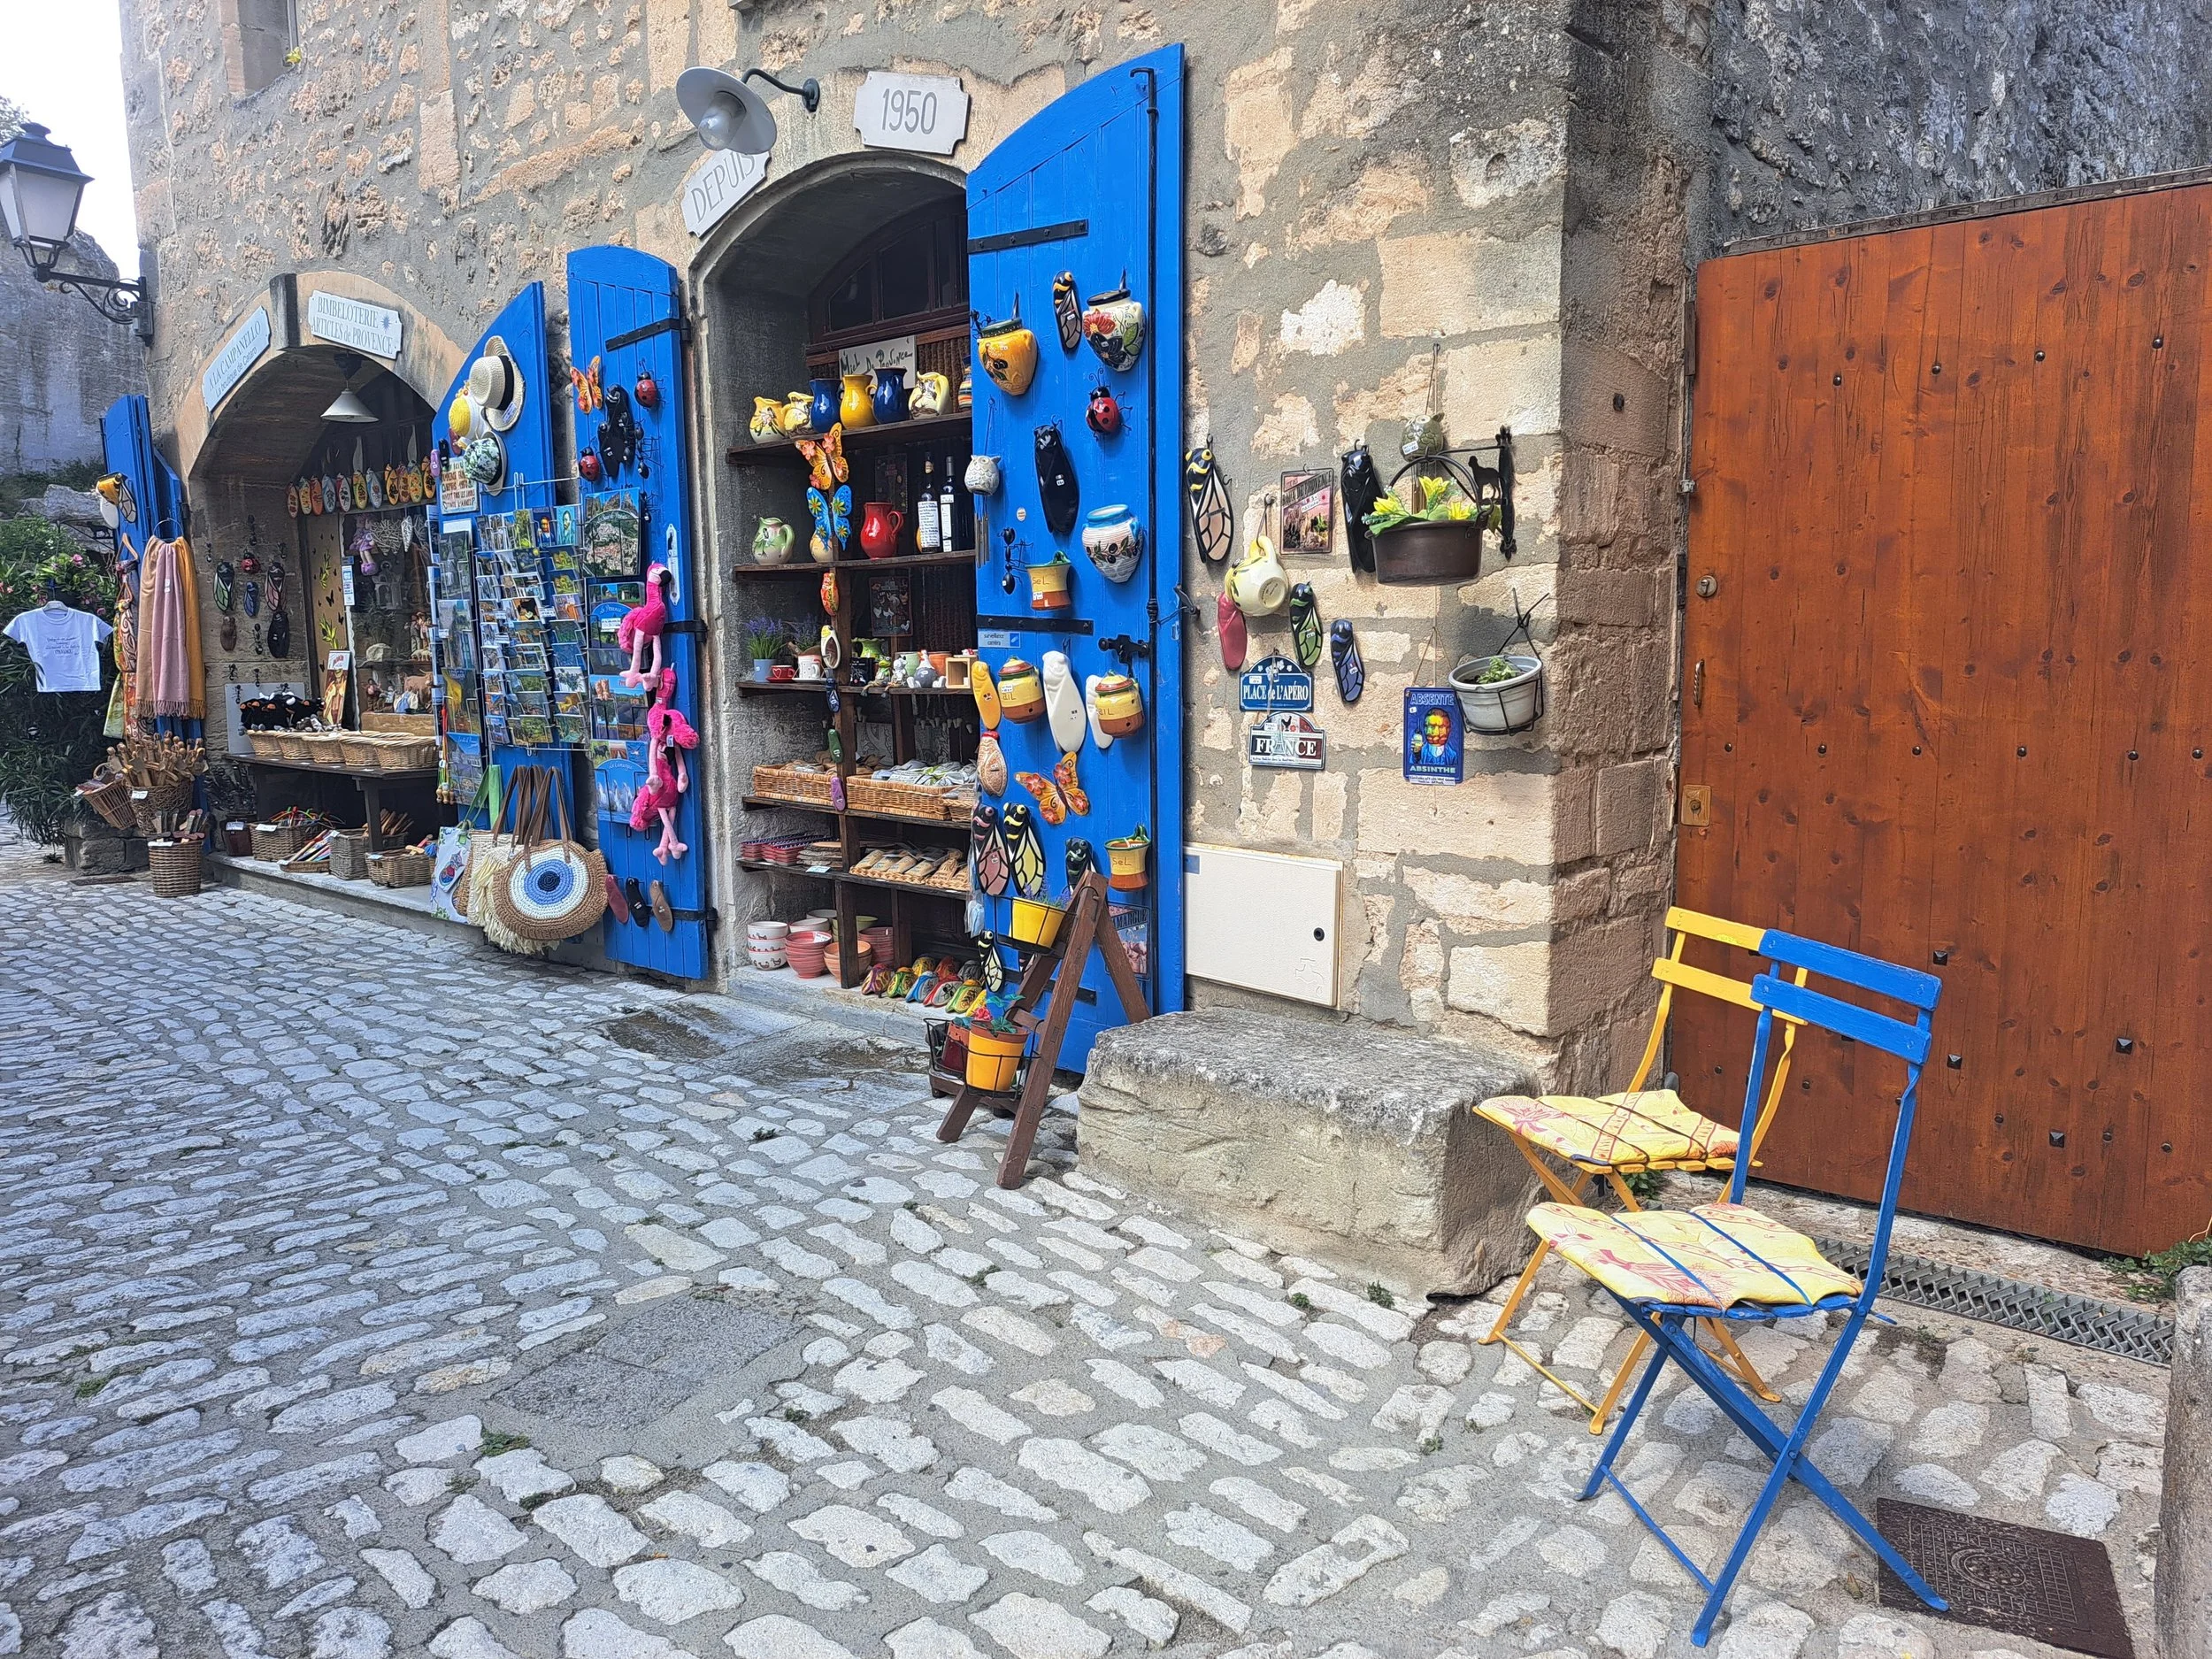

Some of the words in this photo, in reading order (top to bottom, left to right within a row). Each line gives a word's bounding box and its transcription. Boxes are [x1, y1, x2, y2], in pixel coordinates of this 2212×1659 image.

[882, 88, 937, 134] 1950
[691, 151, 755, 224] DEPUIS
[318, 296, 379, 328] BIMBELOTERIE
[220, 320, 261, 376] CAMPANELLO
[312, 316, 343, 340] ARTICLES
[343, 325, 351, 343] de
[352, 326, 393, 355] PROVENCE
[221, 369, 238, 390] boutique
[237, 361, 243, 372] de
[1243, 685, 1266, 700] PLACE
[1268, 687, 1276, 700] de
[1276, 680, 1309, 700] L'APÉRO
[1410, 694, 1455, 705] ABSENTE
[1255, 738, 1317, 757] FRANCE
[1409, 765, 1455, 774] ABSINTHE
